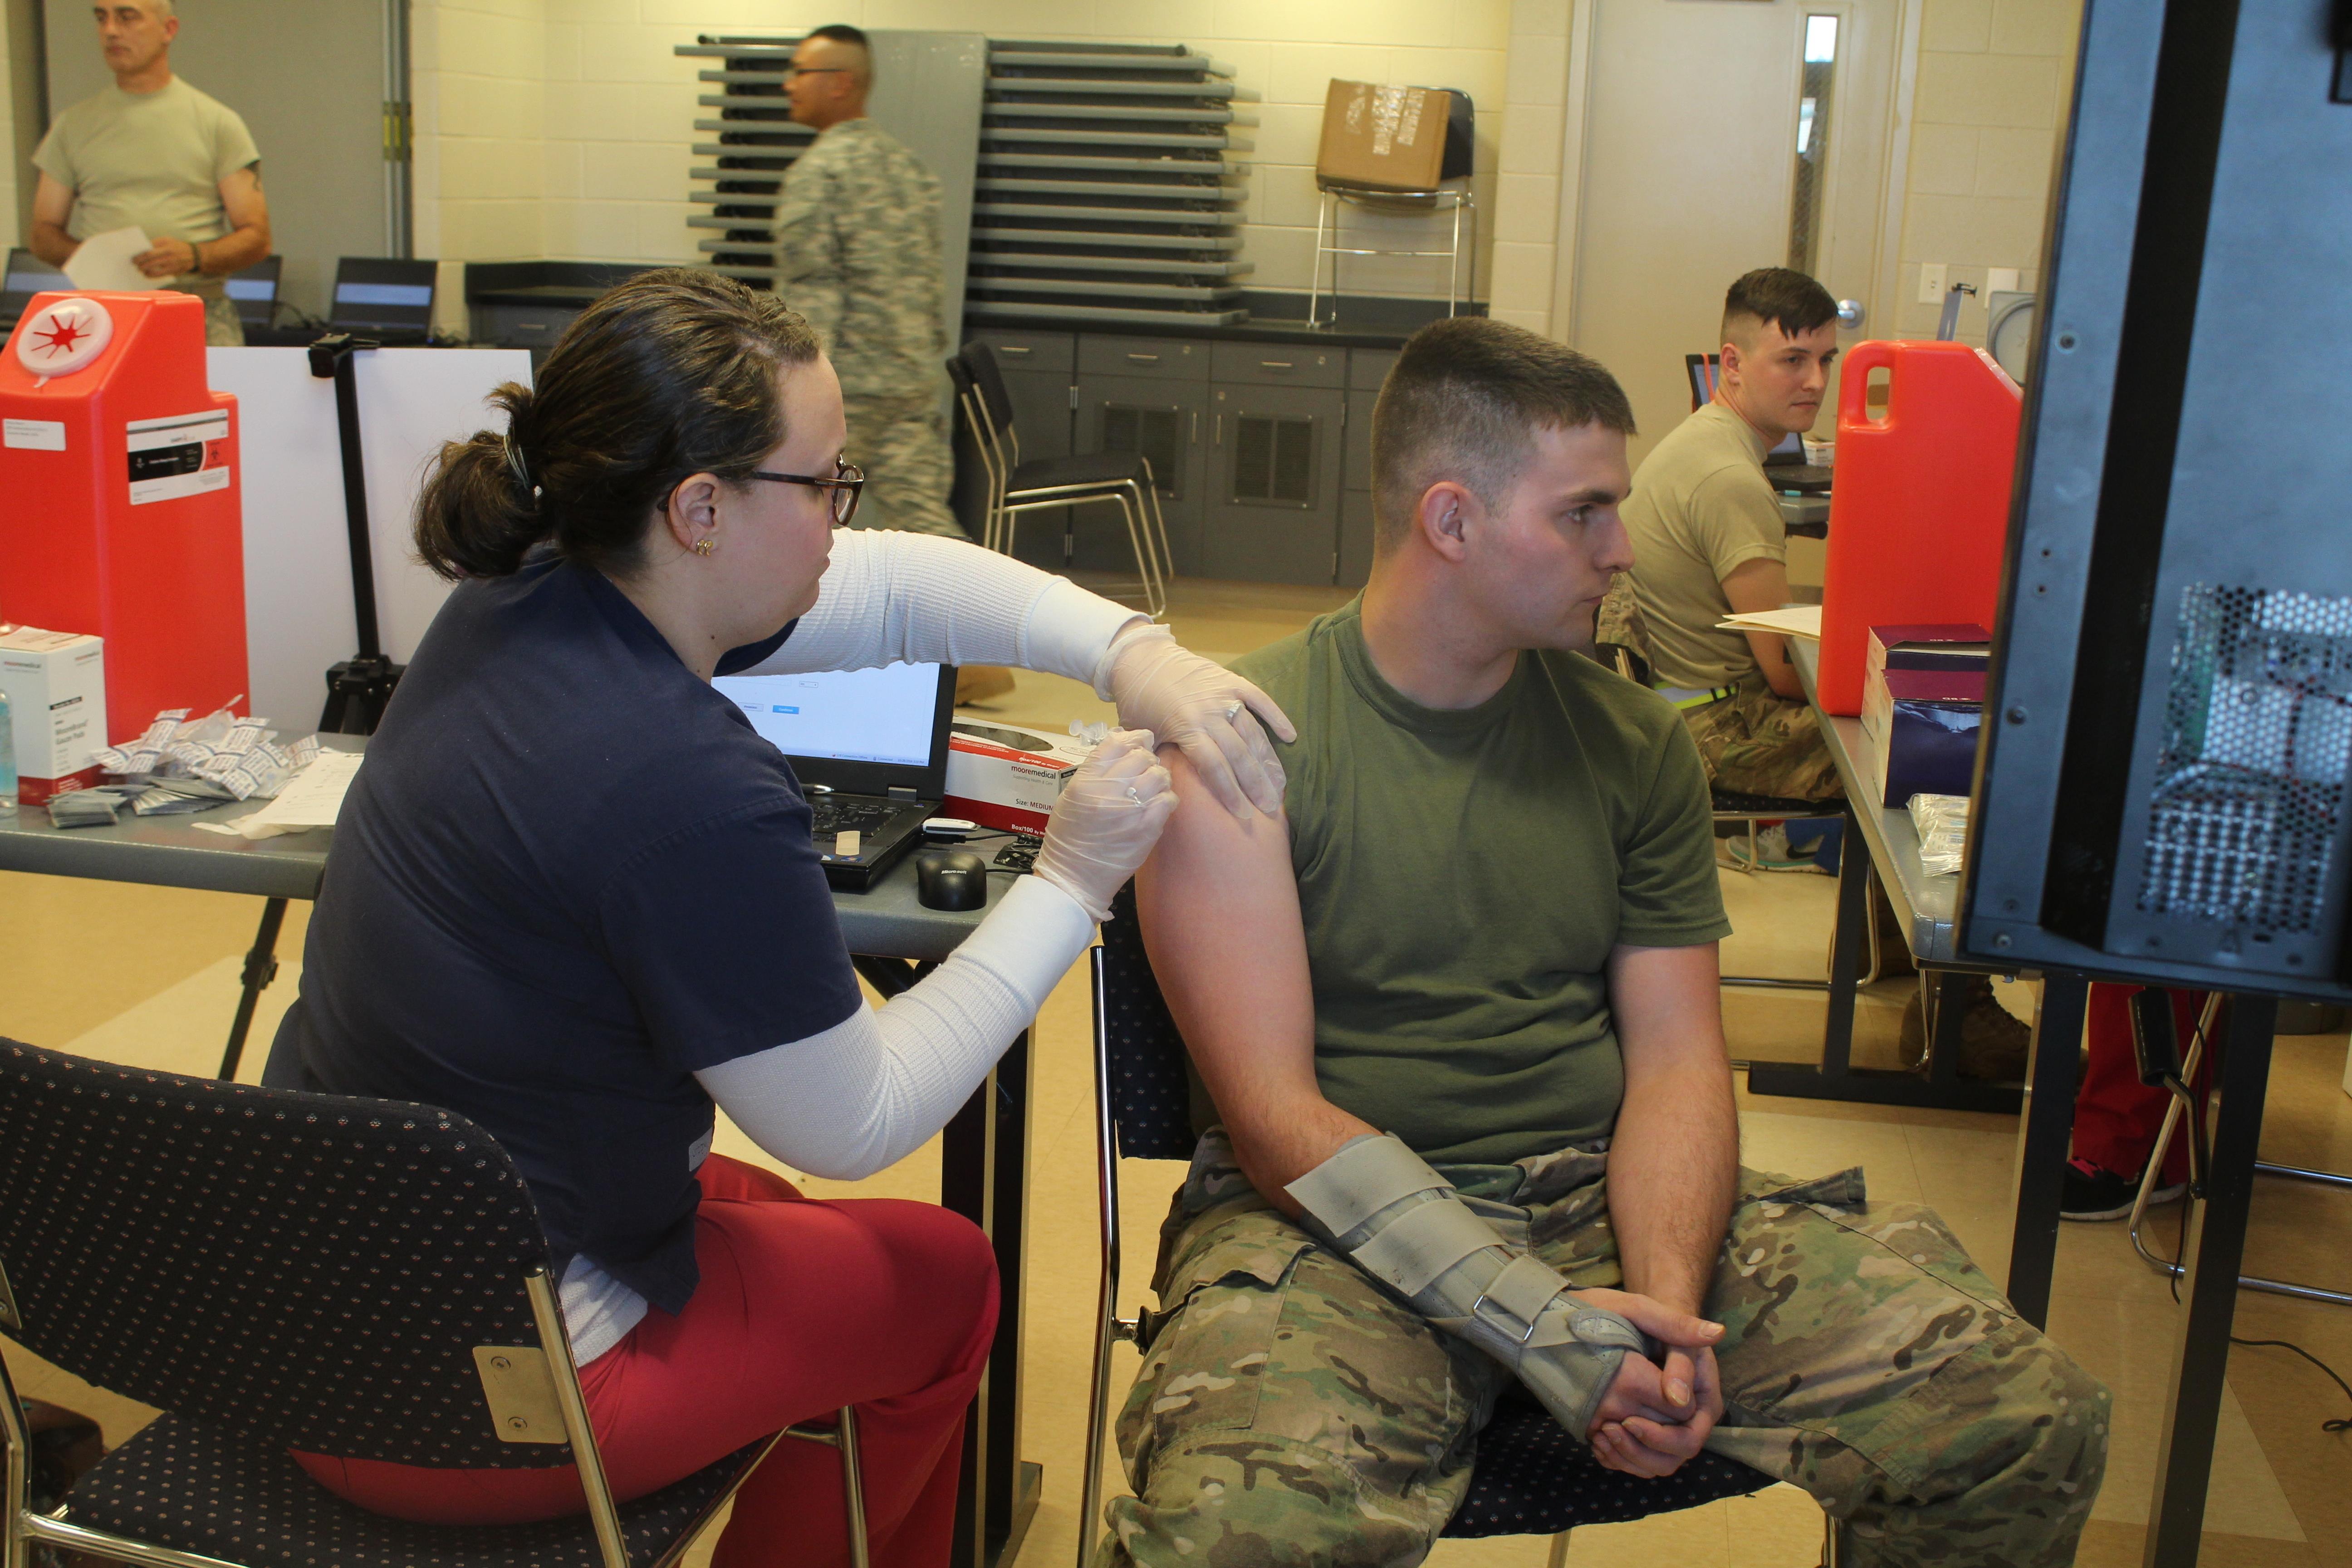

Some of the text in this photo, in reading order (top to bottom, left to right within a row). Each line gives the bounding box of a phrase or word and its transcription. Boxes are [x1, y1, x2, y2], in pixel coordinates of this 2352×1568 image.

[1011, 766, 1056, 780] mooremedical
[1013, 774, 1031, 783] Supporting
[1011, 824, 1034, 833] Box/100
